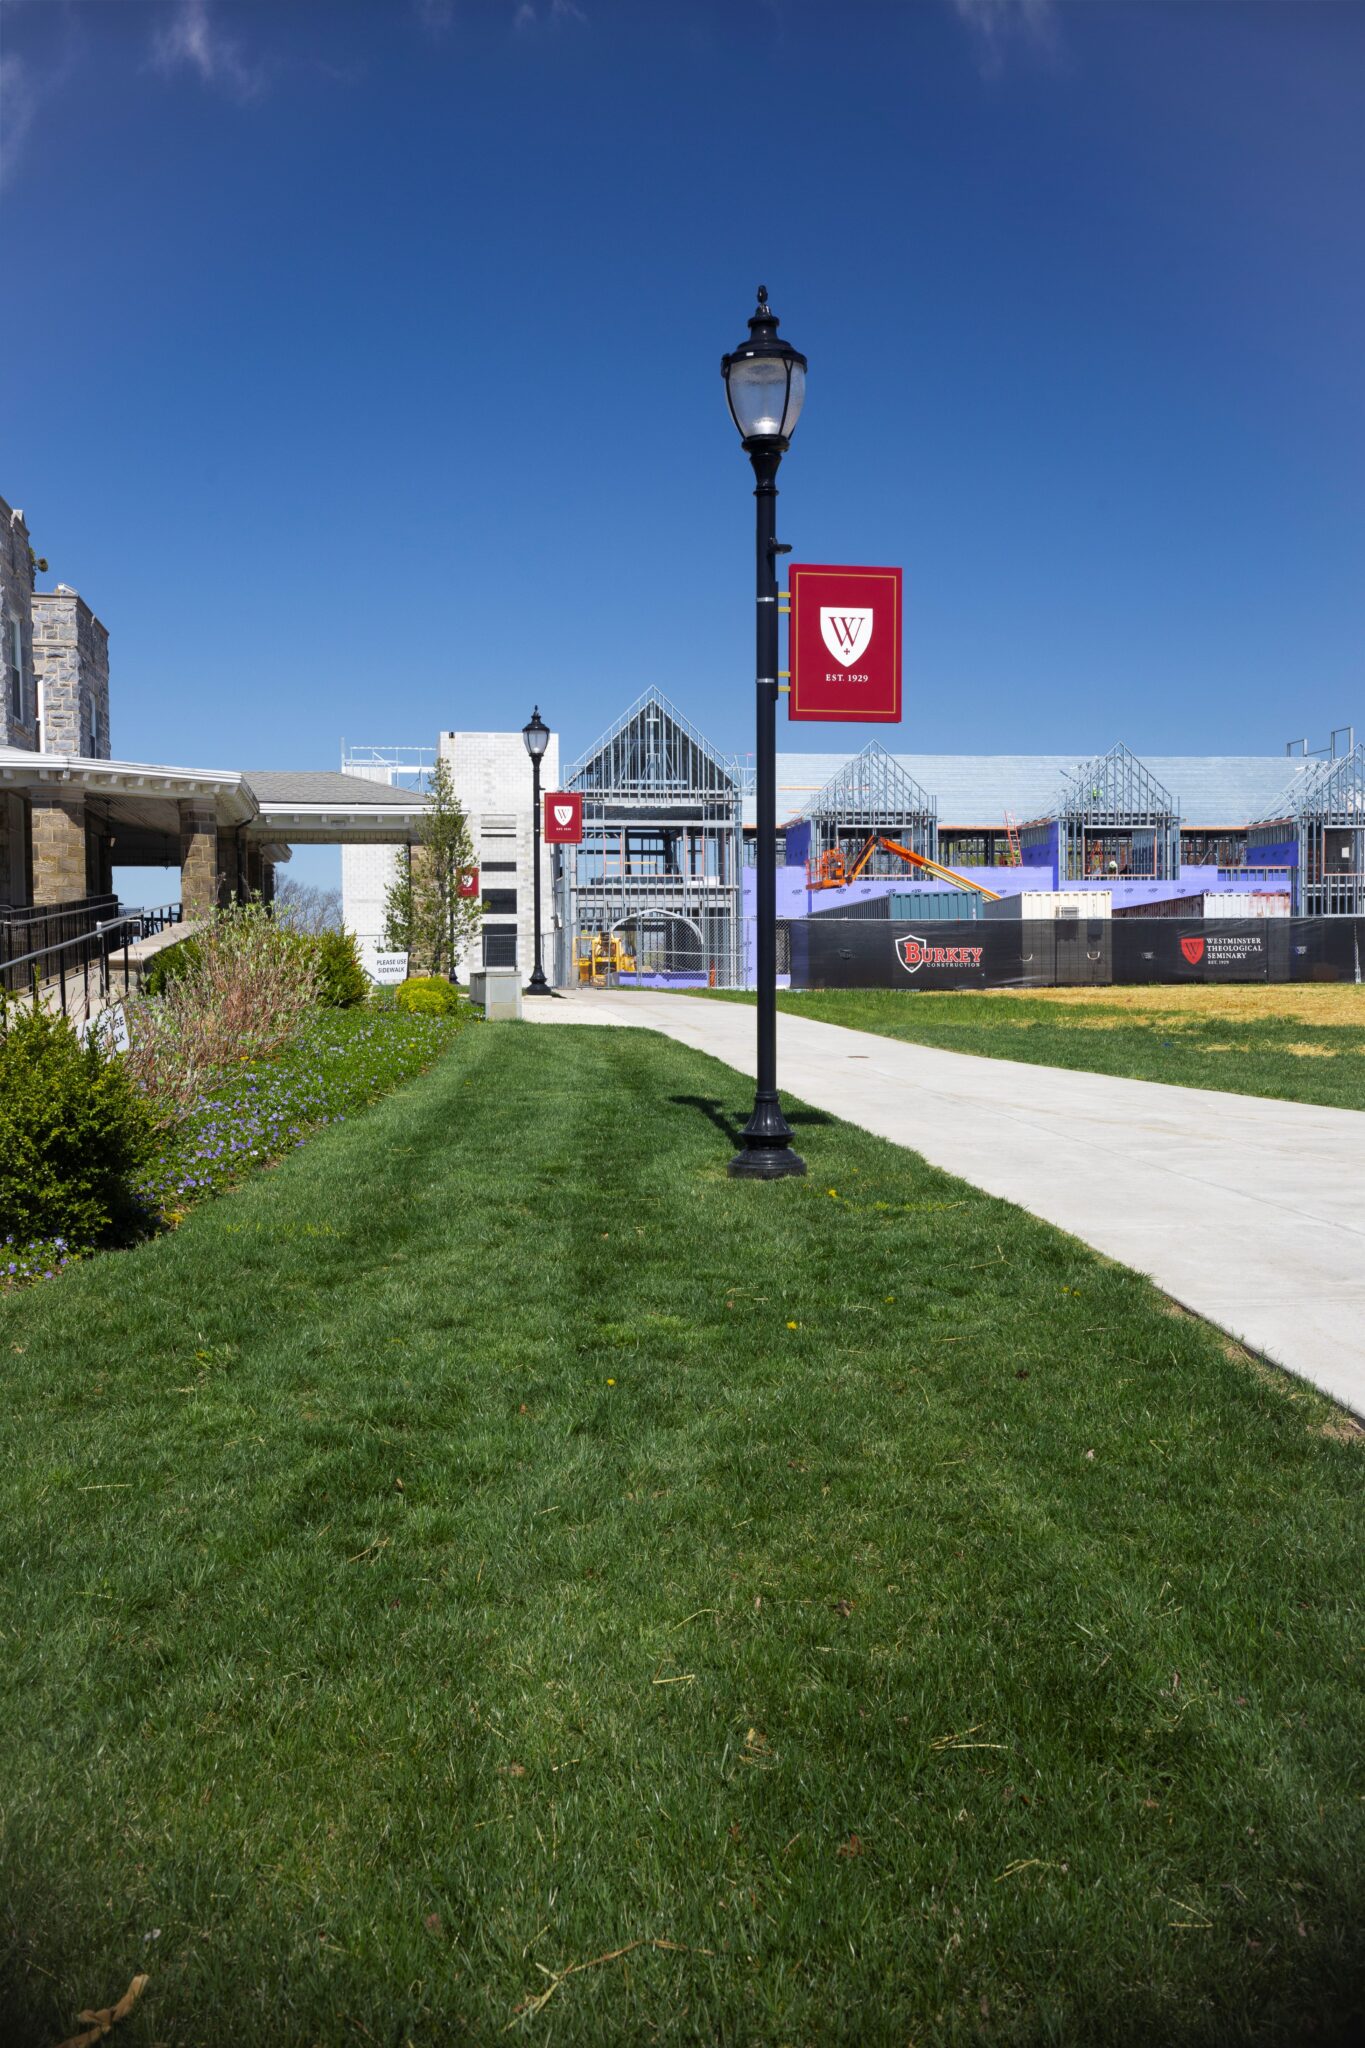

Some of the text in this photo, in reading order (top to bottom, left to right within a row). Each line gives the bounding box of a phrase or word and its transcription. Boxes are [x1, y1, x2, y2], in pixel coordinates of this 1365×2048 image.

[828, 616, 865, 647] W
[825, 674, 869, 682] EST. 1929
[904, 942, 983, 963] BURKEY
[1185, 942, 1201, 956] W
